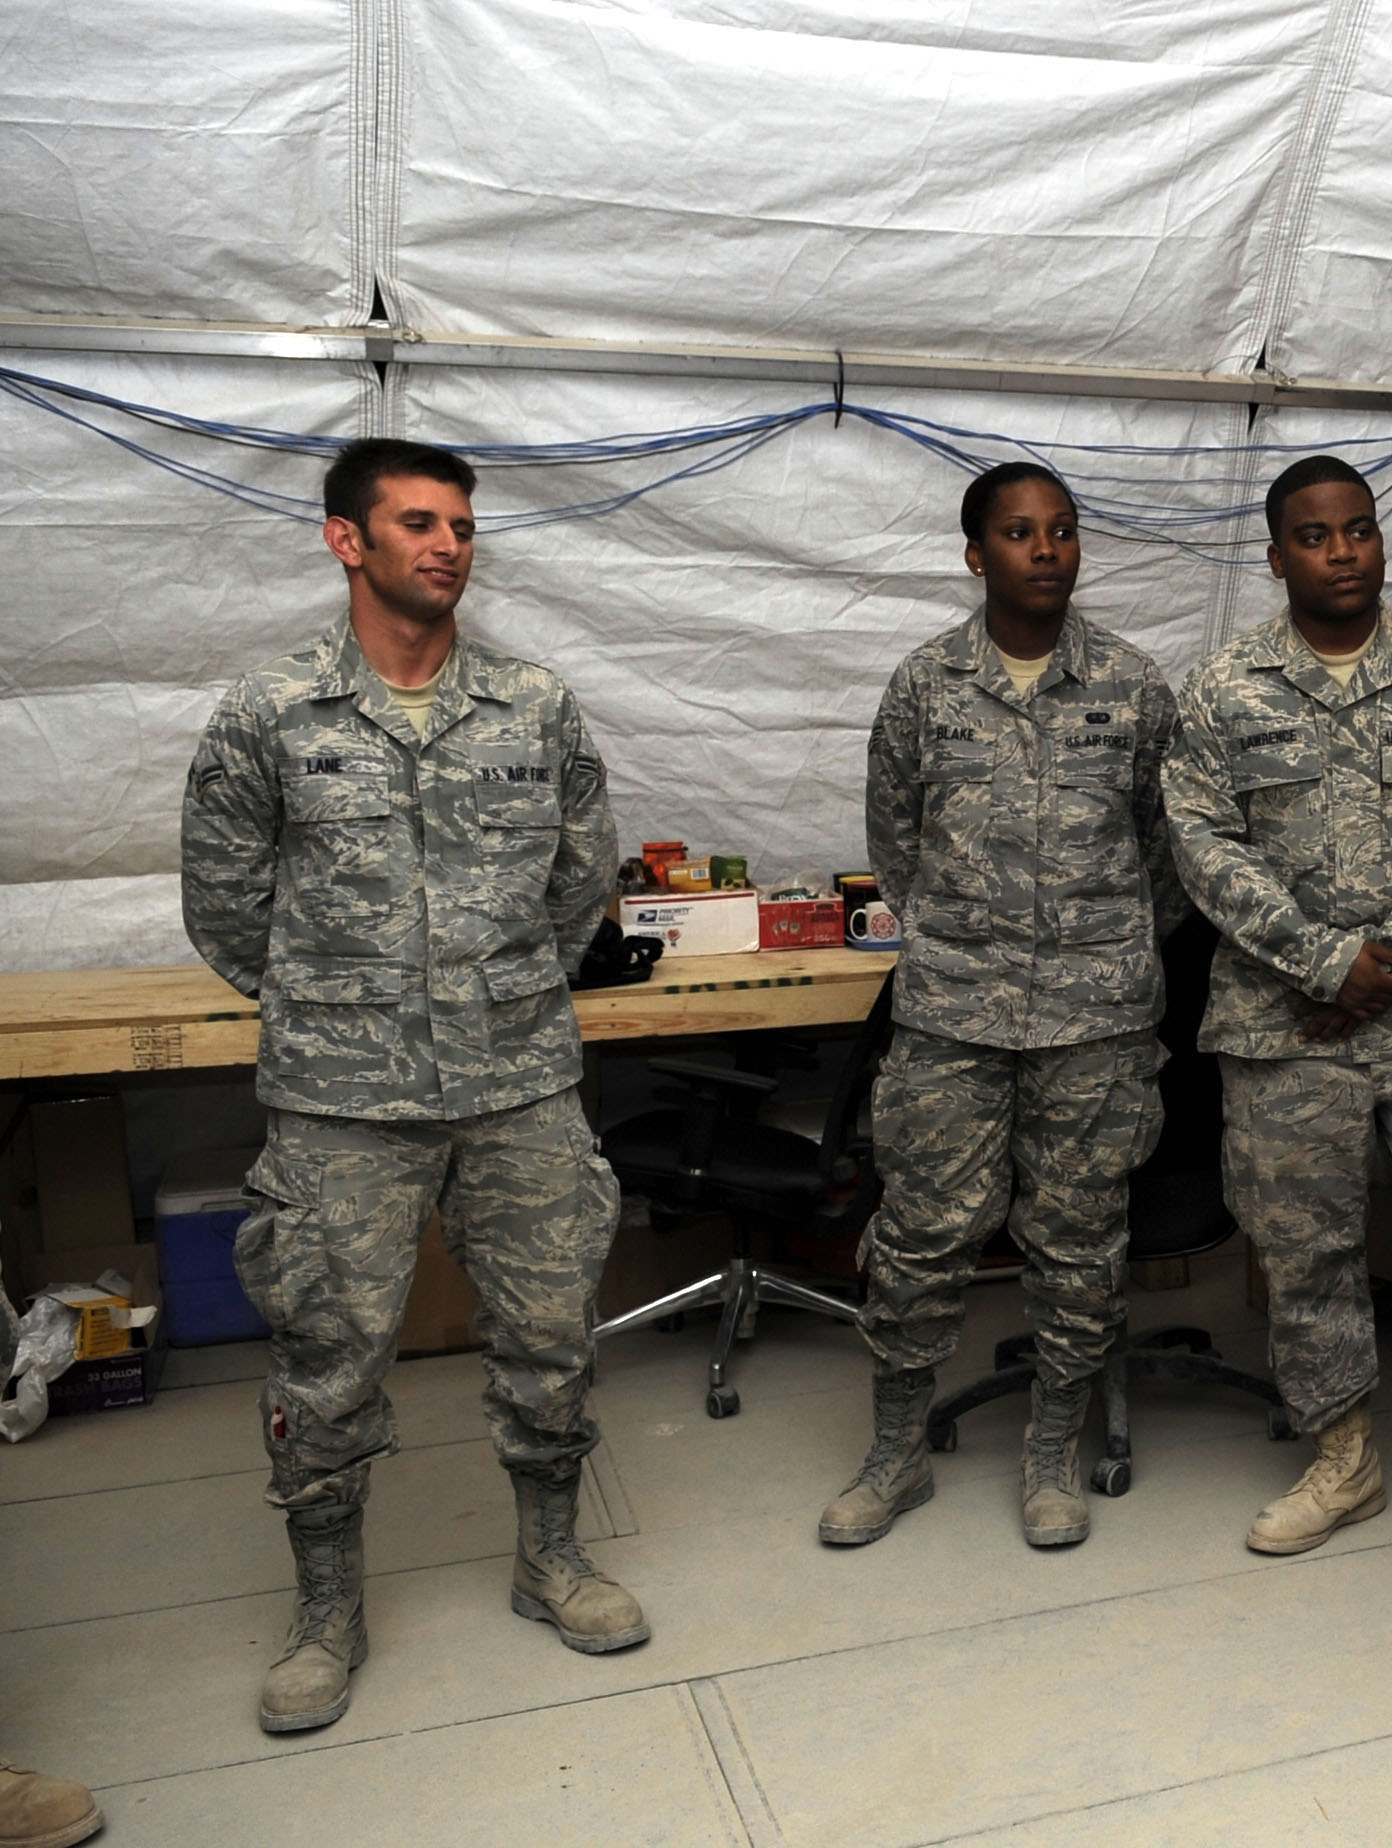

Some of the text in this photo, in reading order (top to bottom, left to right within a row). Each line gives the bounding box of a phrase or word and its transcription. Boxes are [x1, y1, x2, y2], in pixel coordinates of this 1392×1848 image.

[936, 726, 975, 742] BLAKE
[1085, 735, 1102, 747] AIR
[1239, 729, 1297, 750] LAWRENCE
[306, 758, 343, 774] LANE
[482, 767, 504, 782] U.S.
[508, 766, 528, 781] AIR
[102, 1367, 142, 1379] GALLON
